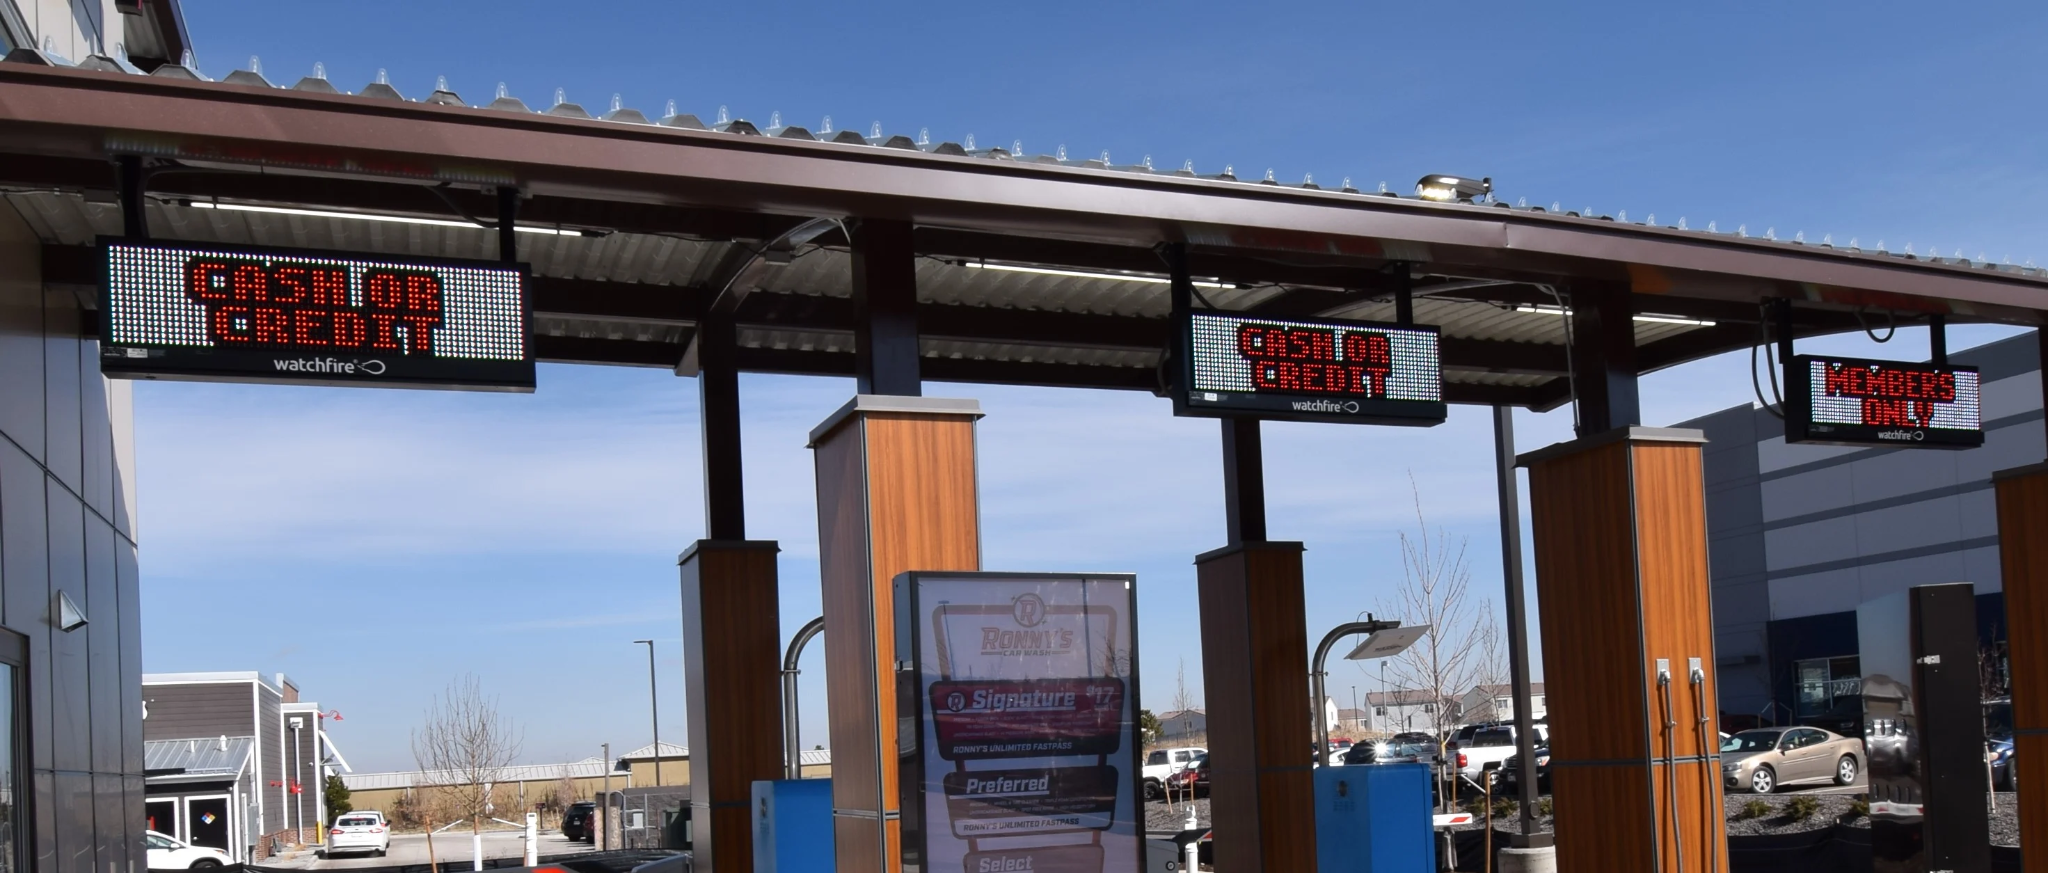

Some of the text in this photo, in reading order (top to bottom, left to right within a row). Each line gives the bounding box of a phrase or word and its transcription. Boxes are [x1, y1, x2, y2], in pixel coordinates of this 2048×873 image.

[193, 262, 441, 312] CASH OR
[215, 305, 440, 351] CREDIT
[1242, 328, 1390, 364] CASH OR
[273, 357, 356, 375] watchfire
[1256, 360, 1390, 394] CREDIT
[1828, 366, 1956, 399] MEMBERS
[1292, 400, 1341, 413] watchfire
[1864, 399, 1934, 427] ONLY
[1877, 430, 1912, 441] watchfire
[981, 627, 1074, 650] RONNY'S
[972, 689, 1076, 712] Signature
[953, 742, 1073, 754] RONNY'S UNLIMITED FASTPASS
[966, 776, 1050, 794] Preferred
[963, 818, 1080, 832] RONNY'S UNLIMITED FASTPASS
[979, 855, 1033, 873] Select
